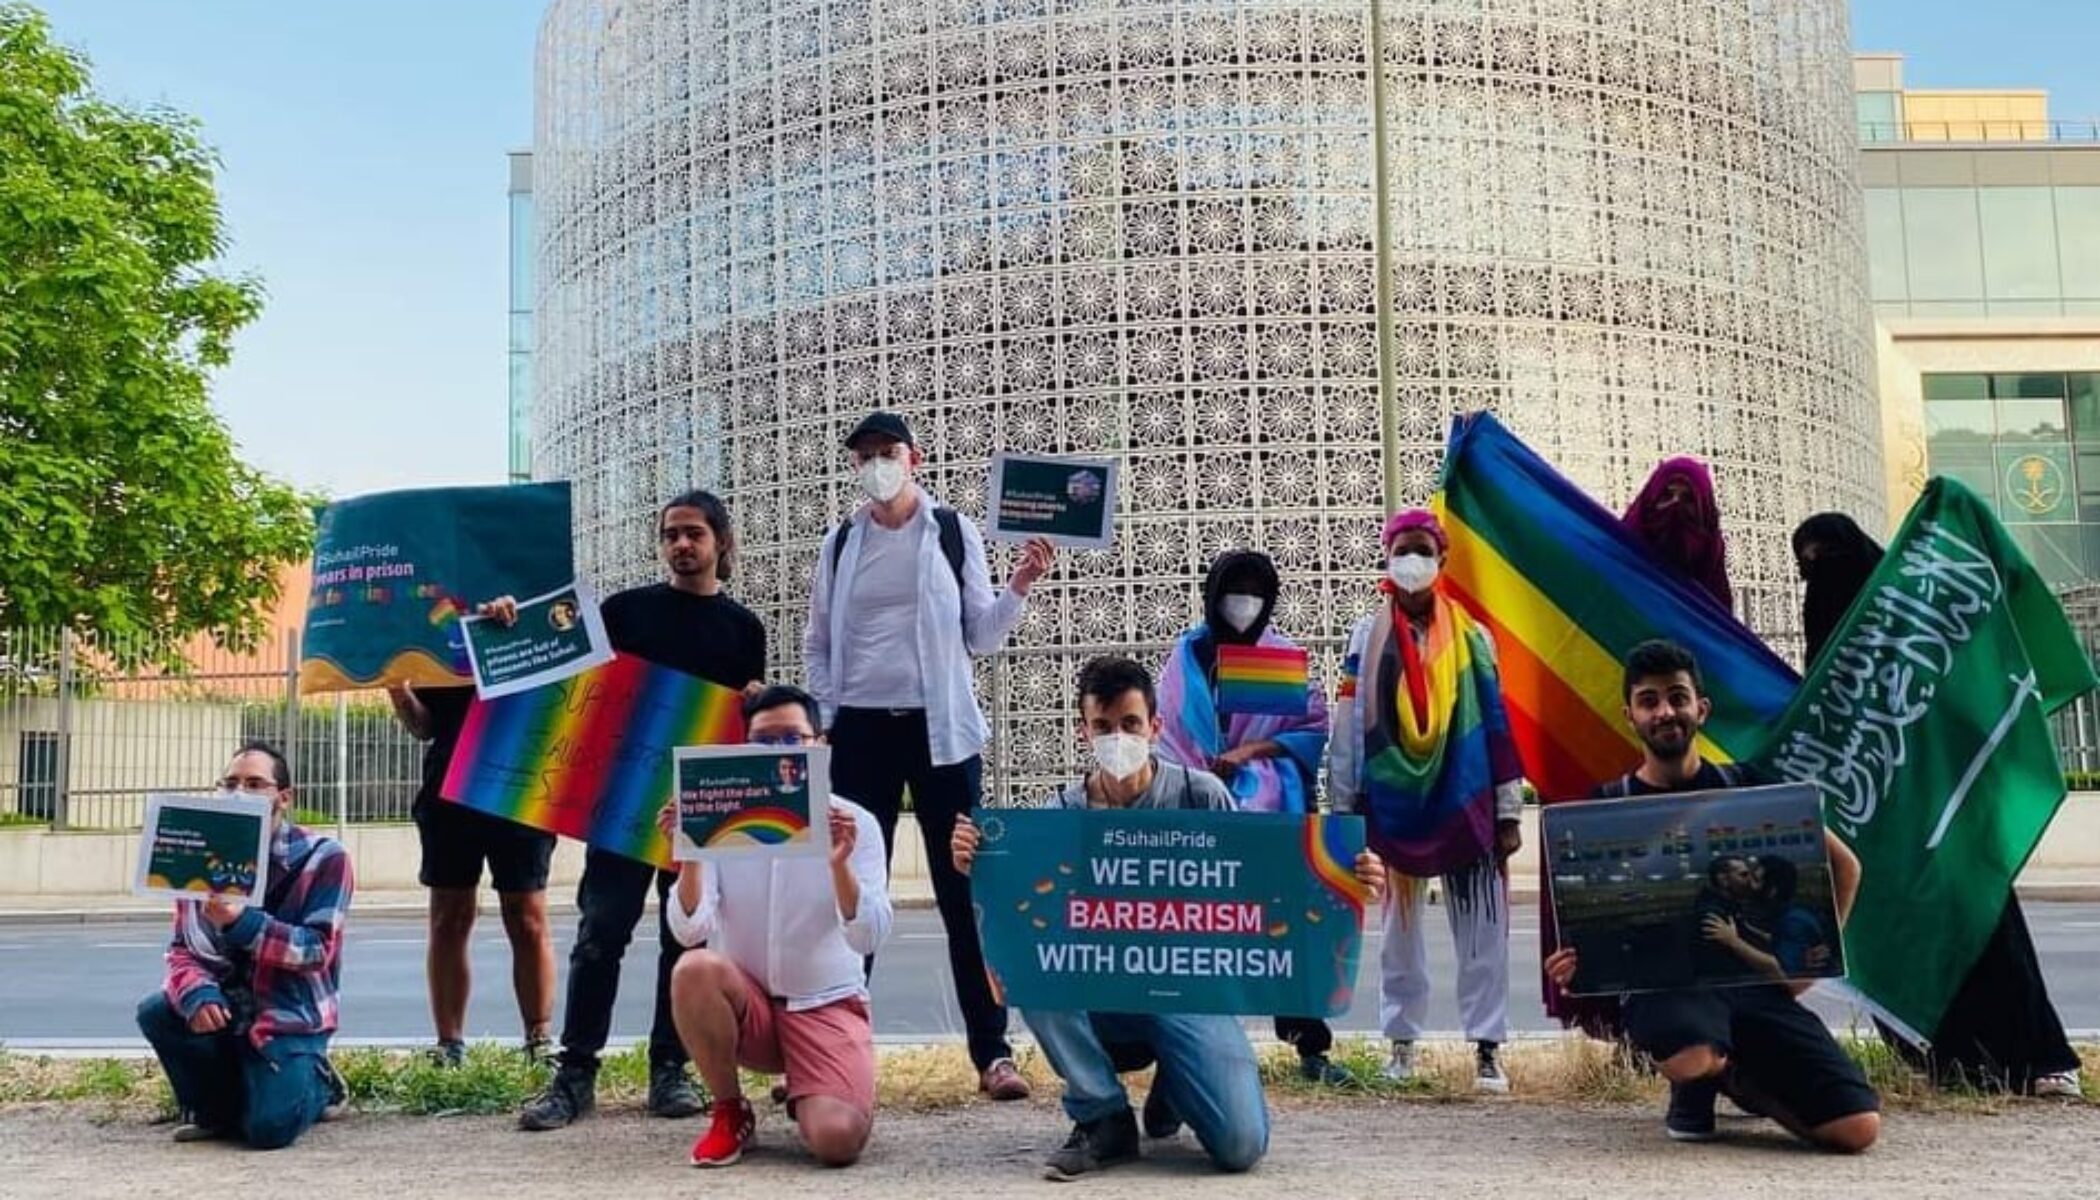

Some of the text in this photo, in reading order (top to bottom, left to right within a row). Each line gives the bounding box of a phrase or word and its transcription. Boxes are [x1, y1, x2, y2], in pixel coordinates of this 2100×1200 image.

[365, 560, 415, 583] prison
[700, 787, 725, 801] fight
[726, 786, 744, 798] the
[681, 803, 694, 815] by
[695, 802, 714, 812] the
[1103, 829, 1217, 848] #SuhailPride
[1091, 858, 1242, 888] WE FIGHT
[1068, 901, 1263, 932] BARBARISM
[1036, 943, 1294, 978] WITH QUEERISM
